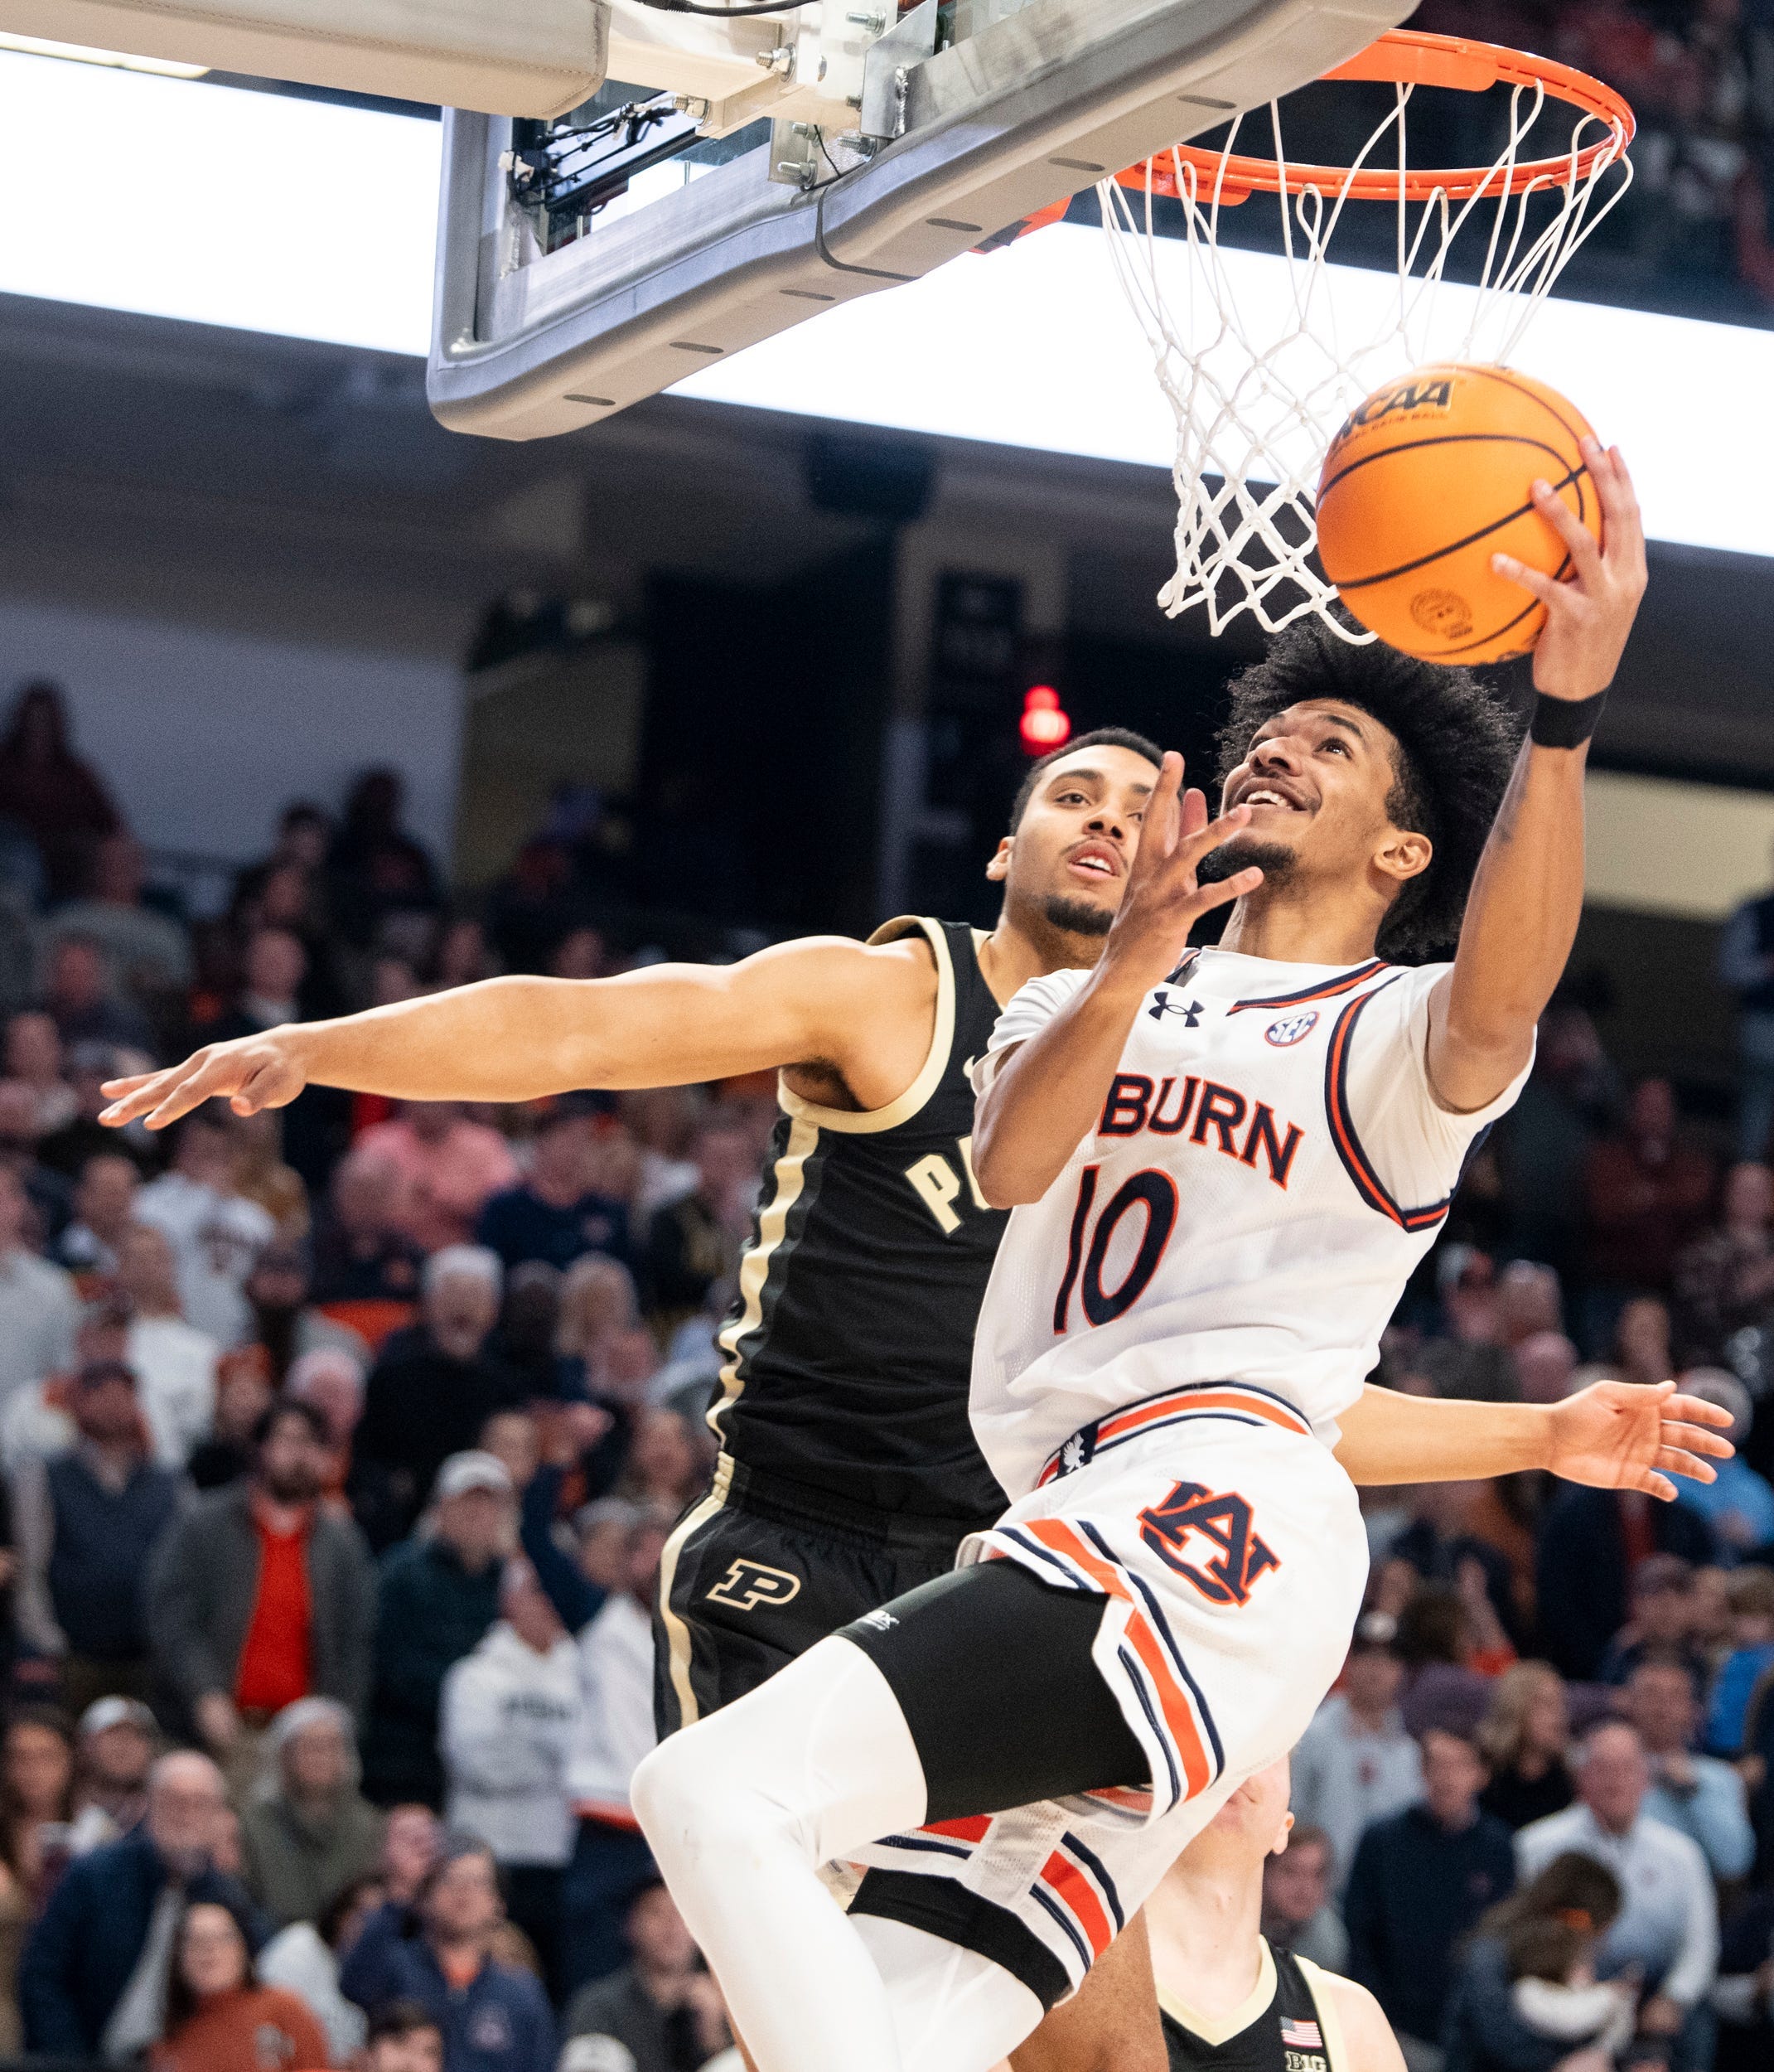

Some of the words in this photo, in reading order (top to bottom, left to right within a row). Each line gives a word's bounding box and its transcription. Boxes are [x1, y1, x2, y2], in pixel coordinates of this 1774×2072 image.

[1267, 1012, 1317, 1044] SEC
[1053, 1164, 1180, 1334] 10
[705, 1558, 801, 1610] P
